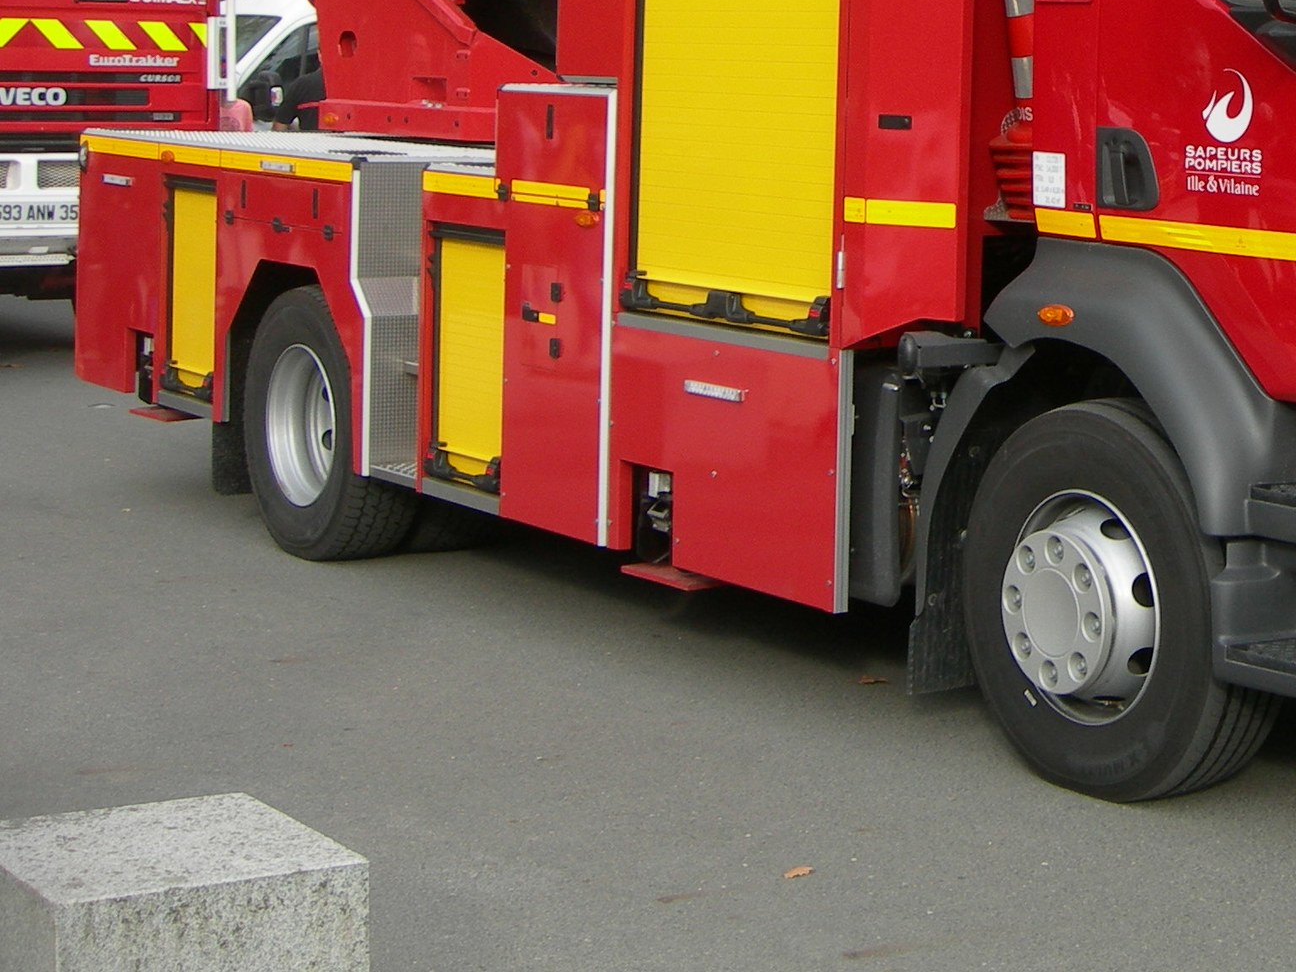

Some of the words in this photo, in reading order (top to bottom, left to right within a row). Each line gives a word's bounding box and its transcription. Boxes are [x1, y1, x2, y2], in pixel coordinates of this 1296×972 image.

[89, 54, 180, 68] EuroTrakker
[139, 74, 182, 83] CURSOR
[1185, 145, 1262, 162] SAPEURS
[1185, 157, 1262, 175] POMPIERS
[1187, 175, 1205, 192] Ille
[1218, 178, 1260, 197] Vilaine
[27, 204, 55, 221] ANW
[60, 204, 79, 221] 35
